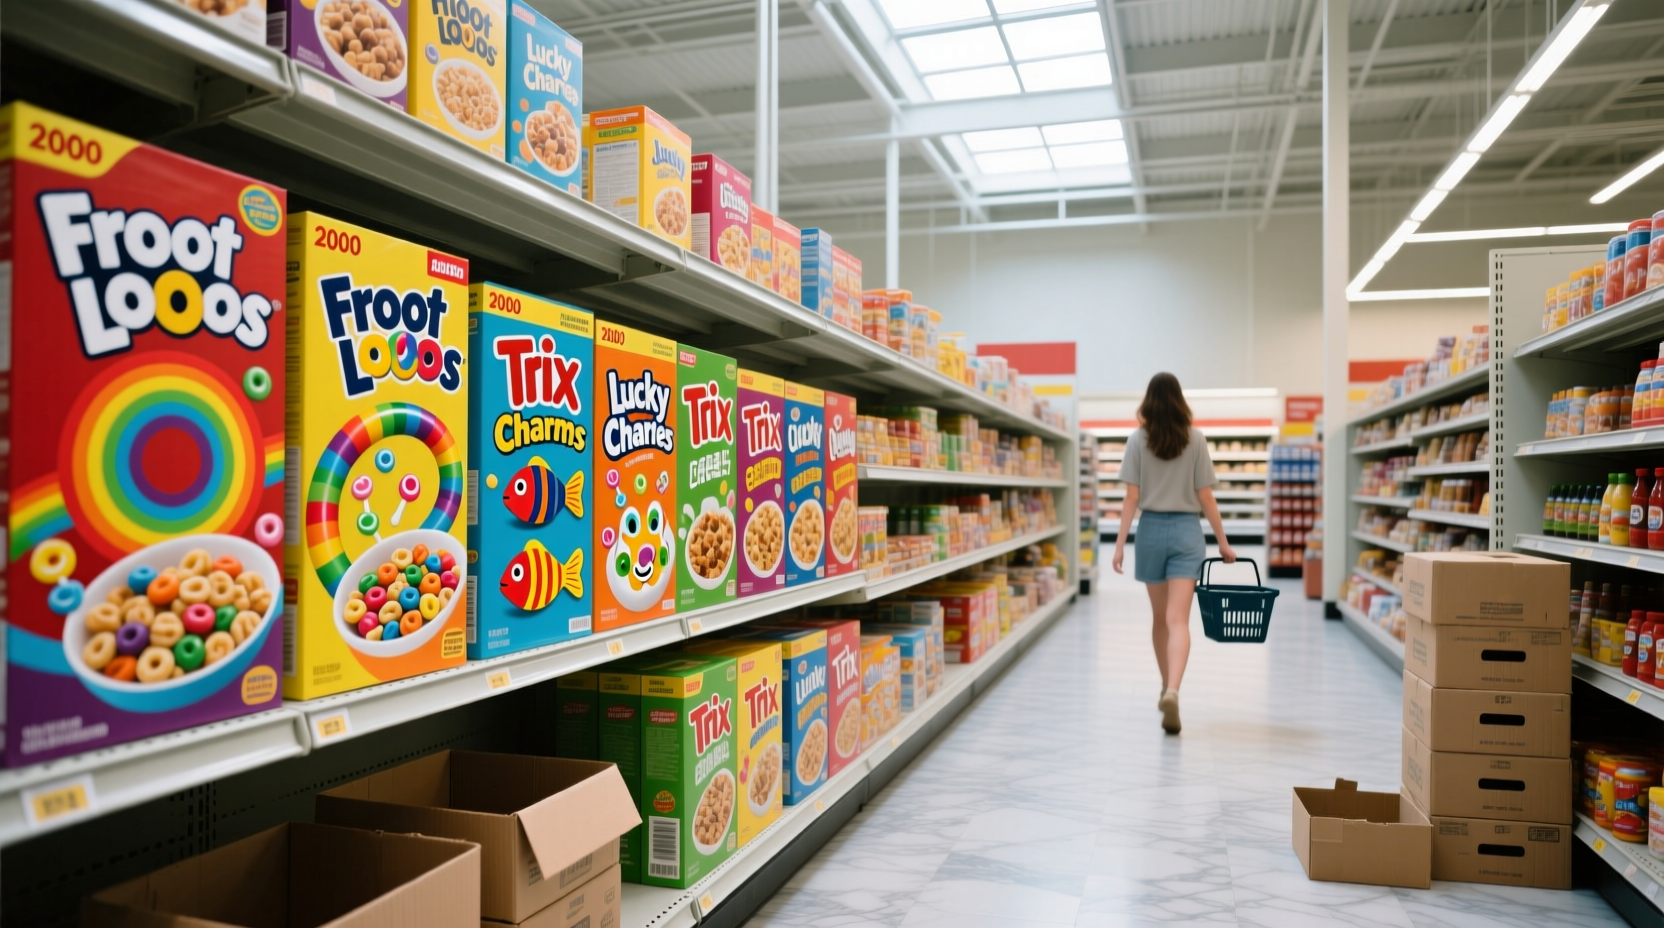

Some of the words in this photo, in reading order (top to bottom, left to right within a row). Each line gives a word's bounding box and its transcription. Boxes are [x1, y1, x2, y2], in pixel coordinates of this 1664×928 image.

[526, 32, 572, 82] Lucky
[28, 122, 103, 166] 2000
[37, 190, 244, 282] Froot
[314, 225, 361, 256] 2000
[319, 274, 448, 340] Froot
[489, 291, 521, 315] 2000
[495, 336, 581, 413] Trix
[607, 370, 671, 425] Lucky
[493, 411, 587, 453] Charms
[682, 381, 733, 447] Trix
[743, 402, 781, 454] Trix
[831, 644, 859, 690] Trix
[690, 693, 732, 755] Trix
[744, 676, 779, 729] Trix
